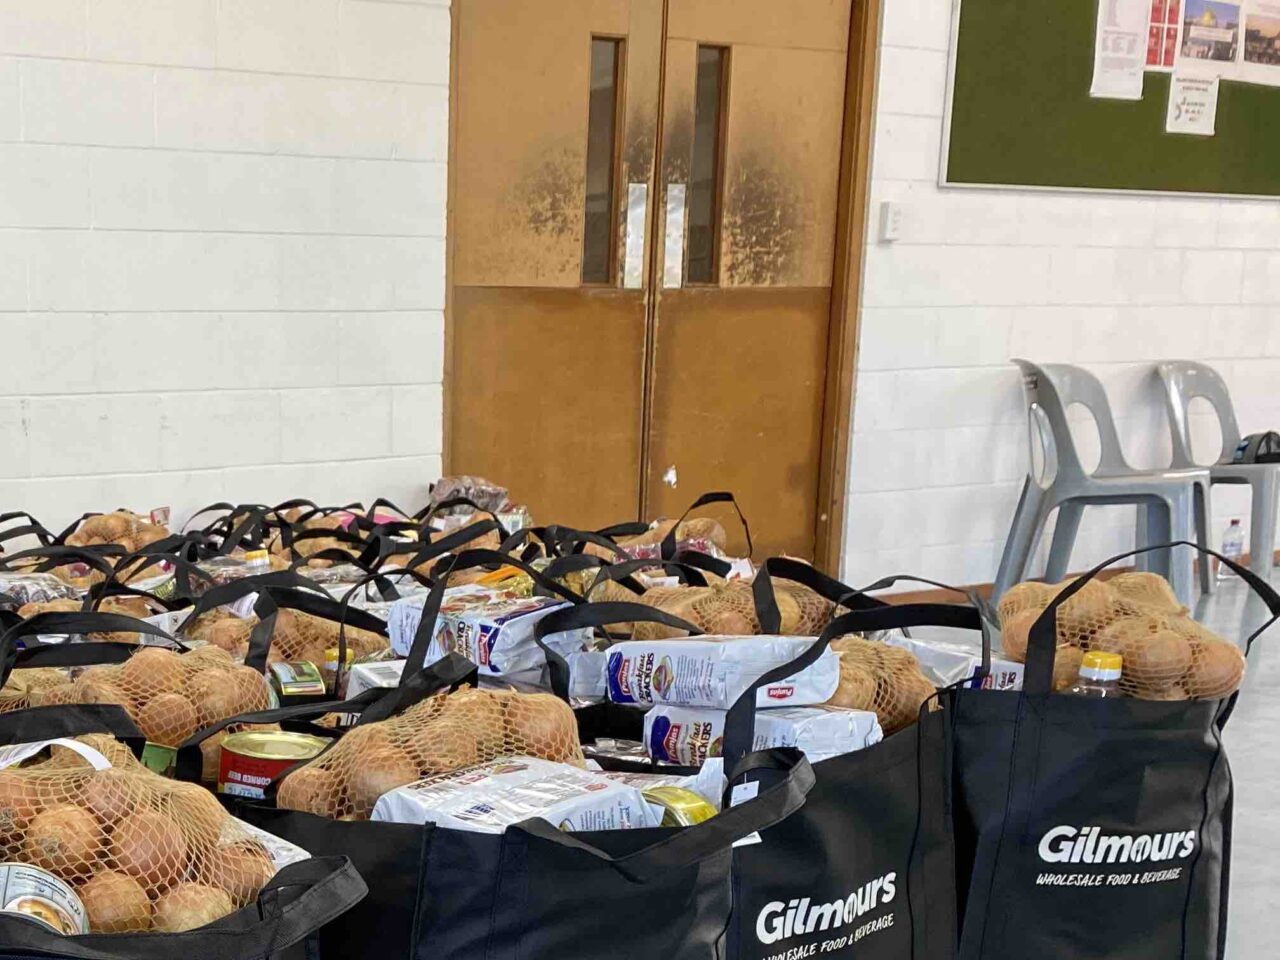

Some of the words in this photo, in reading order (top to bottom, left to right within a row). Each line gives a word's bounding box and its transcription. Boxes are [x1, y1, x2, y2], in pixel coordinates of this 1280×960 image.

[643, 652, 655, 703] CRACKERS
[697, 722, 712, 766] RACKERS
[1038, 825, 1196, 864] Gilmours
[1035, 873, 1105, 887] WHOLESALE
[1106, 873, 1132, 886] FOOD
[1140, 867, 1183, 884] BEVERAGE
[755, 871, 897, 945] Gilmours
[820, 936, 847, 953] FOOD
[854, 913, 895, 942] BEVERAGE
